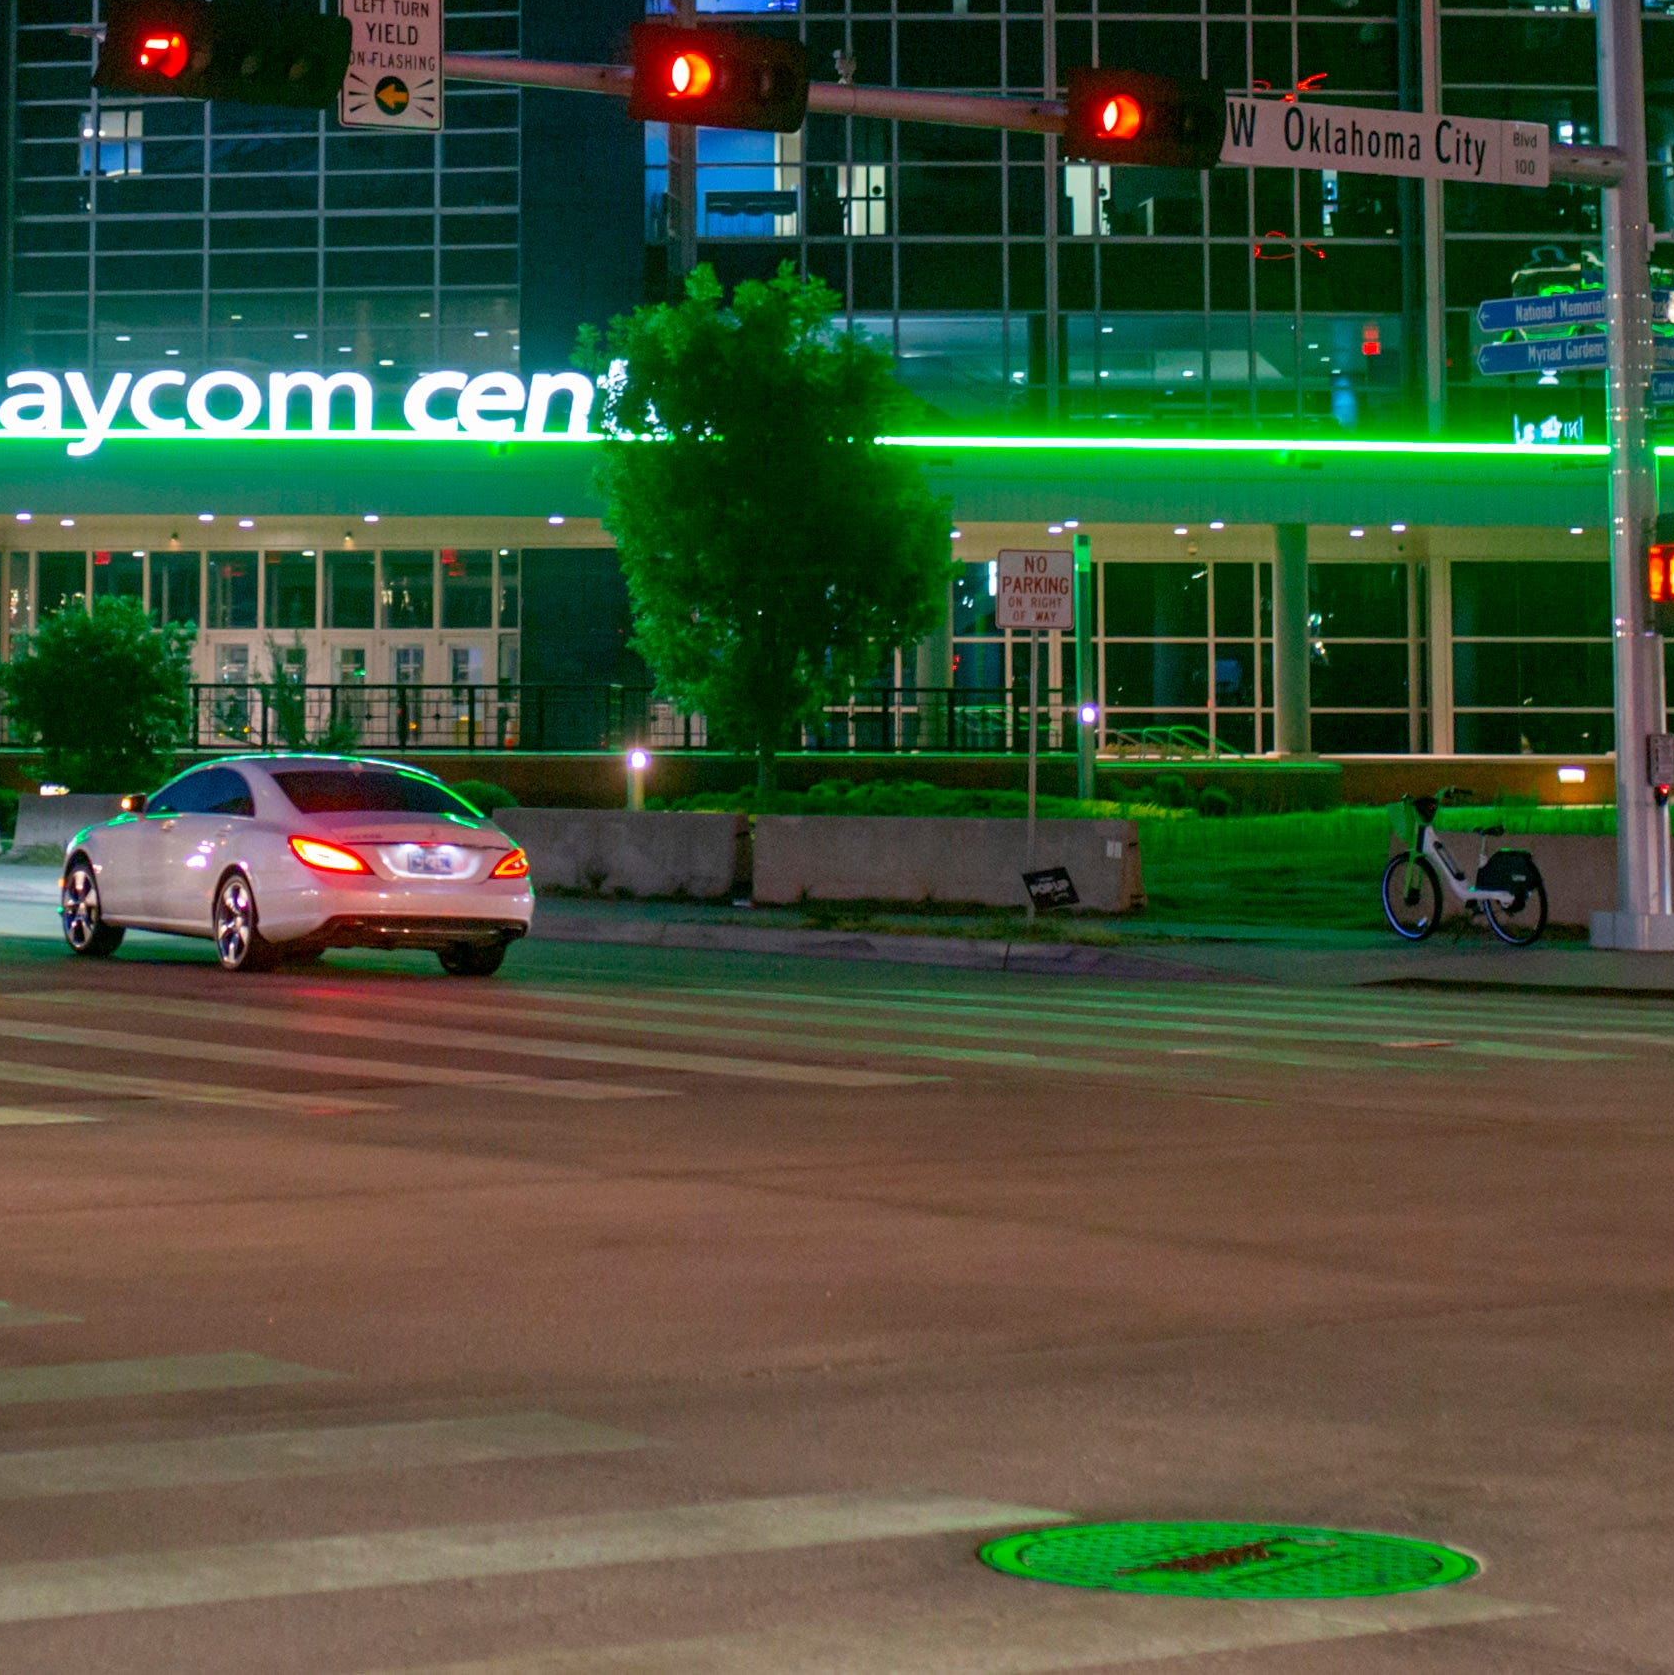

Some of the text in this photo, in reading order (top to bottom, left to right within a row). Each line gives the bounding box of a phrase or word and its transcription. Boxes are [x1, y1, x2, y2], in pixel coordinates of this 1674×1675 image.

[394, 0, 430, 18] TURN
[366, 22, 419, 45] YIELD
[371, 51, 436, 72] FLASHING
[1228, 101, 1487, 176] W Oklahoma City
[1512, 131, 1538, 150] Blvd
[1514, 158, 1536, 176] 100
[1516, 301, 1556, 323] National
[1528, 341, 1605, 367] Myriad Gardens
[1024, 555, 1047, 574] NO
[1002, 575, 1069, 595] PARKING
[1008, 596, 1062, 609] ON RIGHT
[1013, 610, 1057, 623] OF WAY
